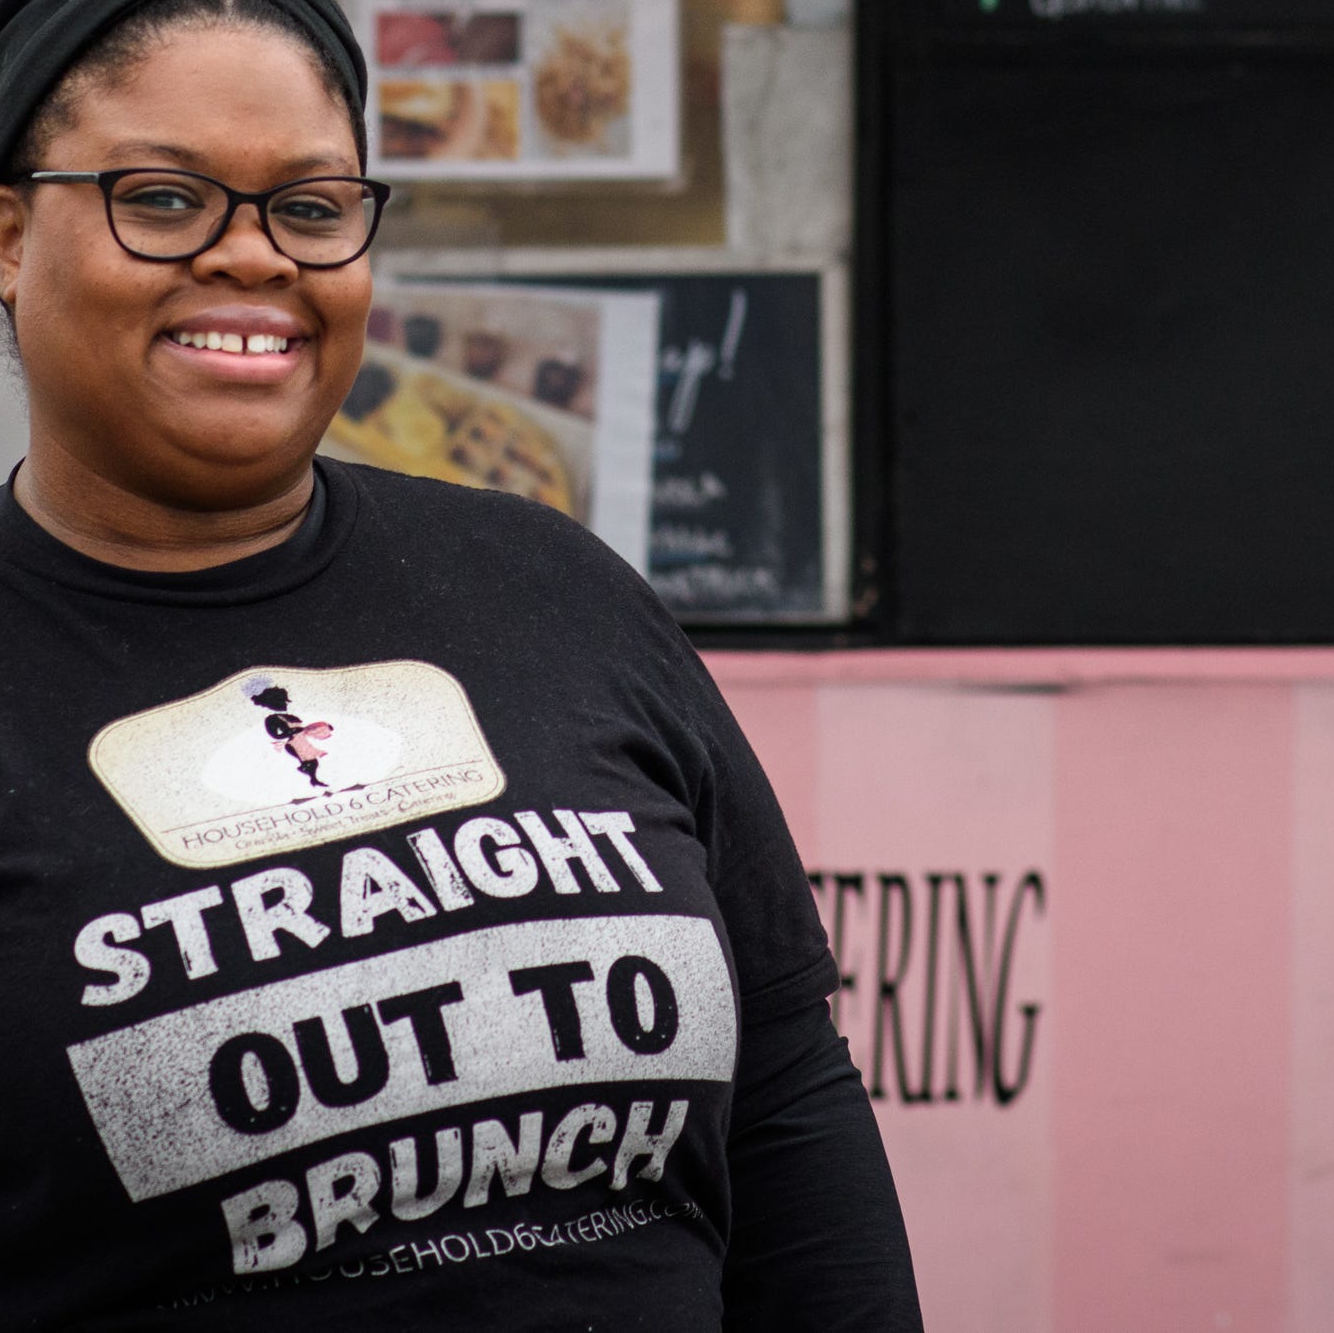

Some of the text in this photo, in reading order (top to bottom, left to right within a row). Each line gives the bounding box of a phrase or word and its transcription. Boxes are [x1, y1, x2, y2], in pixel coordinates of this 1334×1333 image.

[182, 802, 344, 850] HOUSEHOLD
[348, 796, 364, 811] 6
[366, 768, 484, 806] CATERING
[73, 809, 663, 1006] STRAIGHT
[207, 955, 680, 1136] OUT TO
[220, 1099, 690, 1275] BRUNCH
